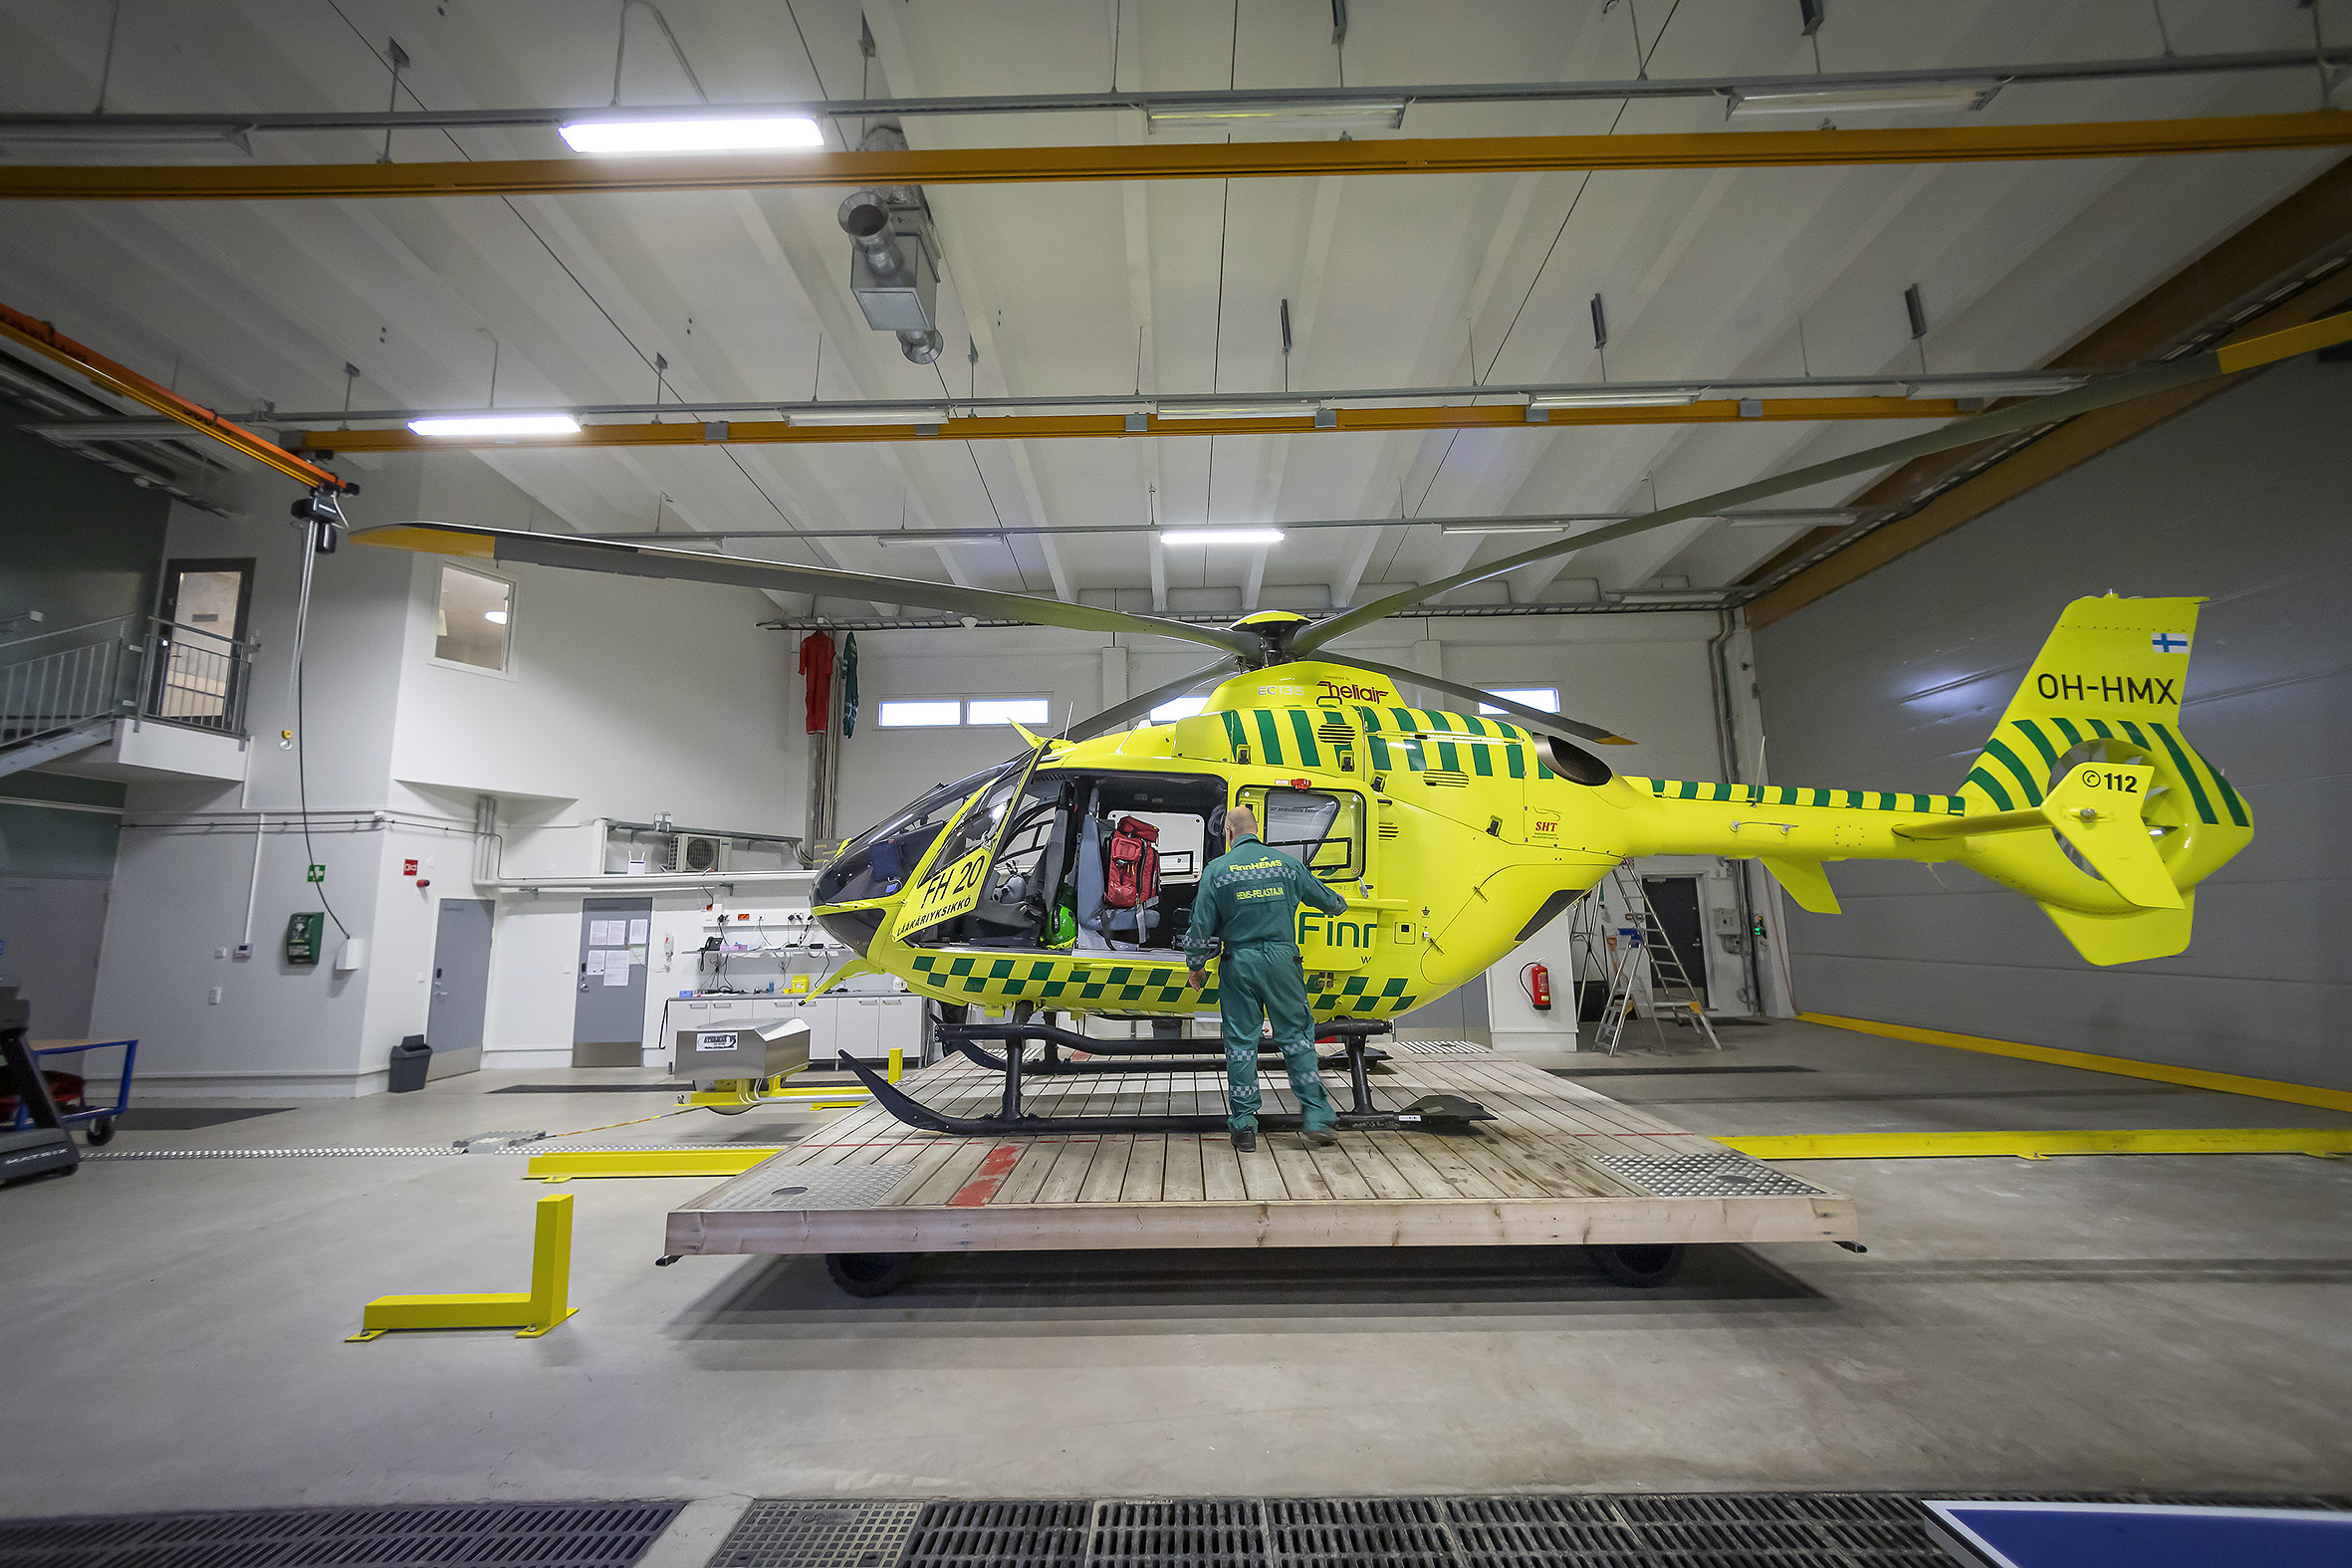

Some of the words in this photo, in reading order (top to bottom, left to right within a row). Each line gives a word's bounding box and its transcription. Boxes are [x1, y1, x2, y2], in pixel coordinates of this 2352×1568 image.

[1258, 685, 1304, 696] EC135
[1316, 680, 1389, 705] heliair
[2037, 673, 2178, 705] OH-HMX
[2103, 773, 2138, 793] 112
[1534, 820, 1558, 832] SHT
[1229, 859, 1283, 872] FinnHEMS
[920, 867, 956, 909] FH
[952, 855, 985, 895] 20
[1236, 886, 1285, 900] HEMS-PELASTAJA
[896, 894, 972, 937] LÄÄKÄRIYKSIKKÖ
[4, 1148, 68, 1165] MATRIX
